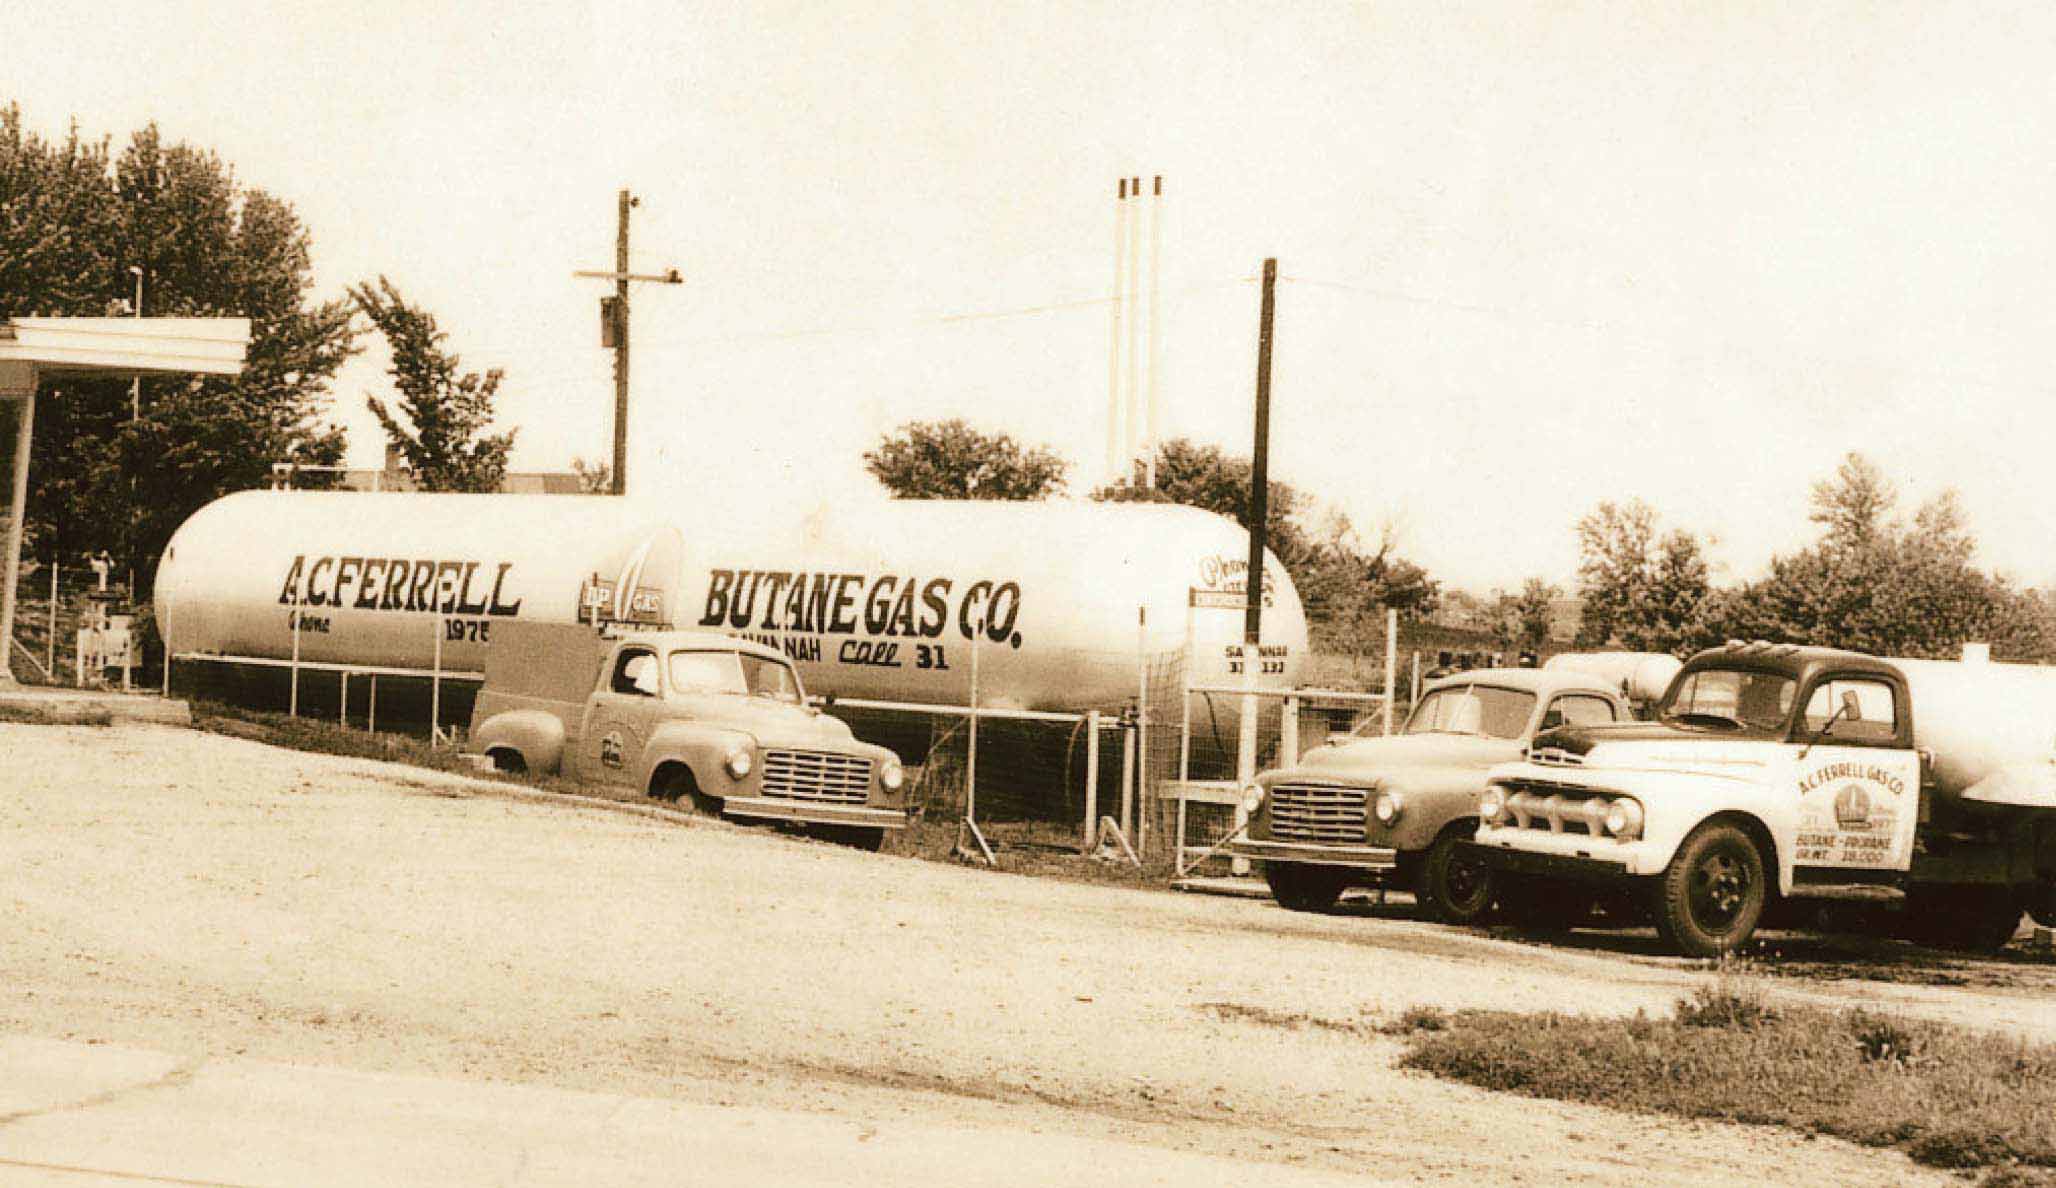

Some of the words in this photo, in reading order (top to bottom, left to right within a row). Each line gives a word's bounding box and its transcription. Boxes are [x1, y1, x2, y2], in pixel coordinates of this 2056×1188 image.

[698, 568, 864, 635] BUTANE
[864, 573, 953, 639] GAS
[957, 579, 1023, 650] CO.
[839, 640, 902, 668] Call
[916, 644, 950, 670] 31
